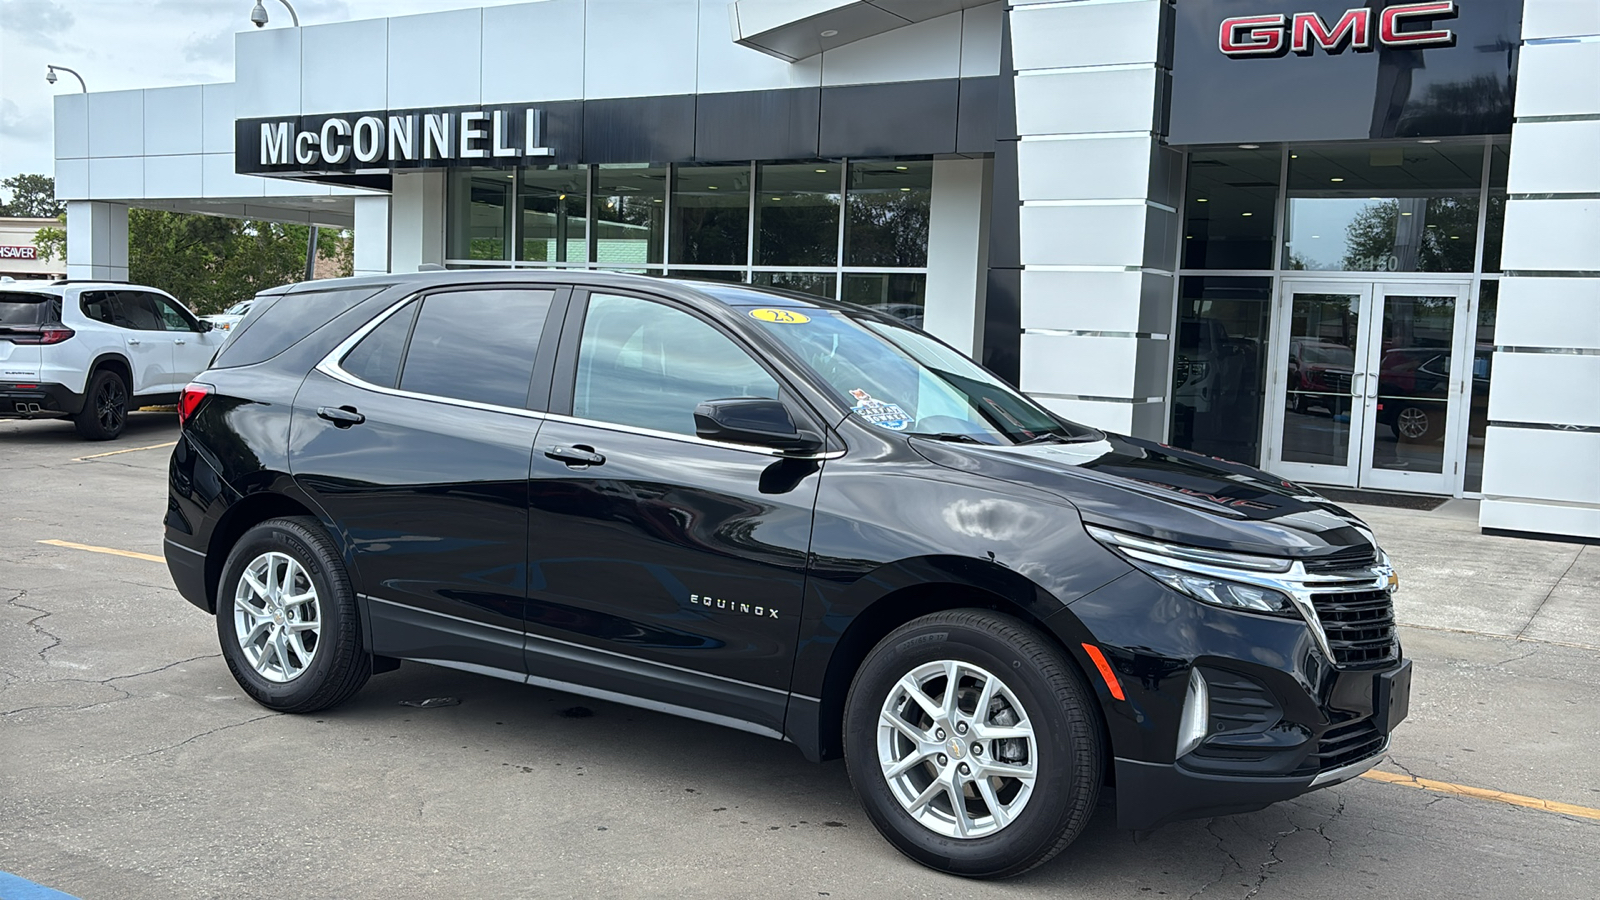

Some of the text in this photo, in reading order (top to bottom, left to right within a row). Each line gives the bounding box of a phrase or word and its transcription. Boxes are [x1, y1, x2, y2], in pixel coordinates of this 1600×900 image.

[1218, 0, 1456, 56] GMC
[260, 108, 555, 165] McCONNELL
[766, 309, 795, 322] 23
[690, 594, 779, 619] EQUINOX
